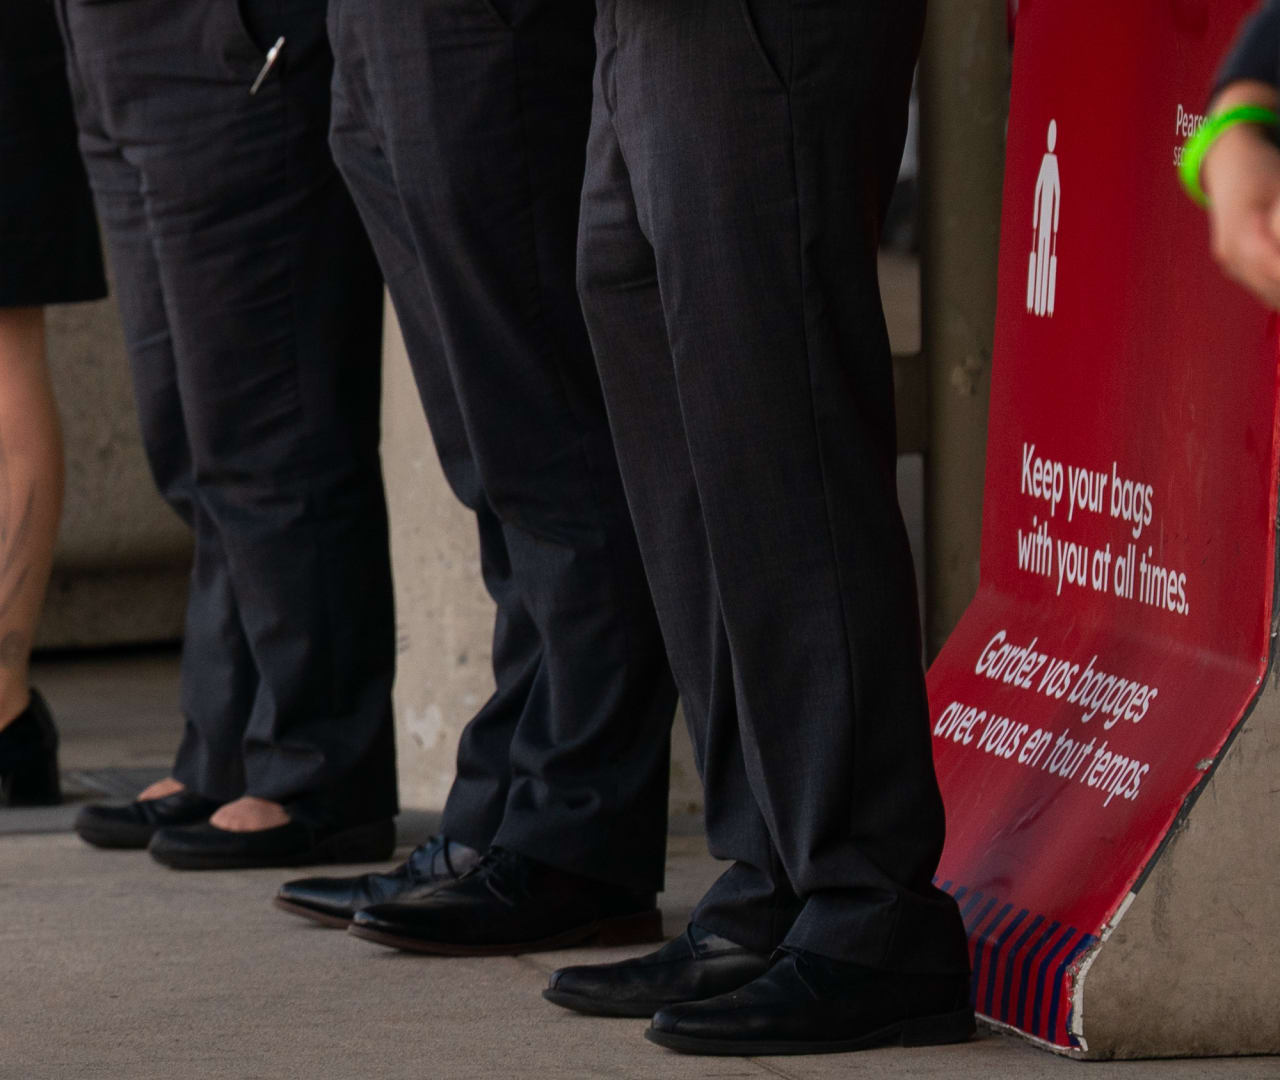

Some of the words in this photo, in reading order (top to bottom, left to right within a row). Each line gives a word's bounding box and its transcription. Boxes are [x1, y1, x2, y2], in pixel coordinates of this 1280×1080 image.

[1176, 104, 1209, 137] Pears
[1021, 442, 1063, 517] Keep
[1068, 465, 1107, 522] your
[1110, 461, 1153, 539] bags
[1018, 515, 1052, 576] with
[1057, 539, 1088, 596] you
[1092, 543, 1111, 592] at
[1114, 543, 1136, 599] all
[1140, 546, 1189, 615] times.
[975, 630, 1048, 689] Gardez
[1037, 657, 1079, 699] vos
[1067, 655, 1158, 729] bagages
[934, 701, 987, 745] avec
[976, 714, 1029, 759] vous
[1018, 728, 1053, 767] en
[1041, 728, 1096, 779] tout
[1080, 741, 1149, 807] temps.
